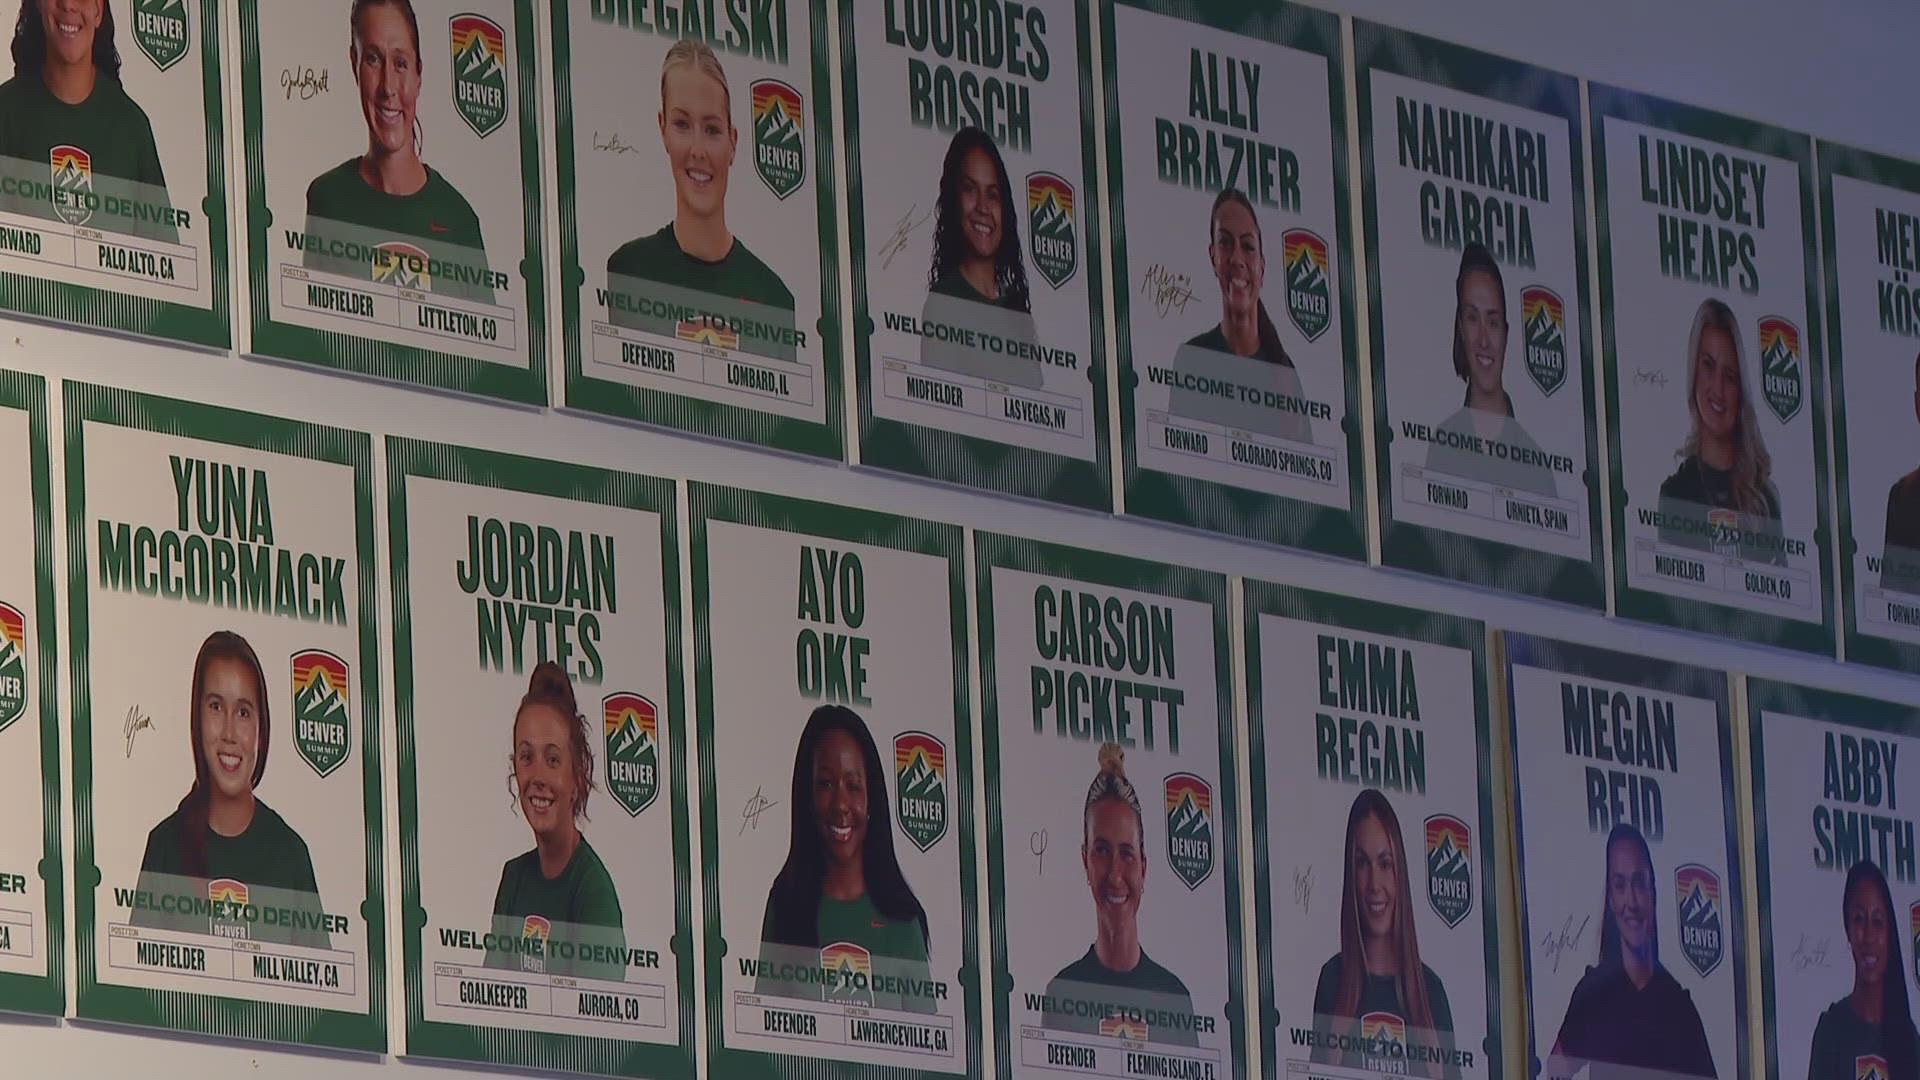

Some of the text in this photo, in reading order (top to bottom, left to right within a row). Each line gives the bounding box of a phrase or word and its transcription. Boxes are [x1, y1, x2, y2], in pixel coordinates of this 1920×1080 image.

[137, 11, 184, 41] DENVER
[884, 0, 1050, 82] LOURDES
[459, 80, 502, 109] DENVER
[908, 57, 1032, 154] BOSCH
[1189, 47, 1260, 133] ALLY
[759, 143, 800, 171] DENVER
[1155, 117, 1301, 213] BRAZIER
[1396, 95, 1549, 203] NAHIKARI
[1639, 135, 1766, 229] LINDSEY
[104, 195, 191, 229] DENVER
[1419, 179, 1536, 271] GARCIA
[98, 245, 175, 280] PALO ALTO, CA
[285, 230, 509, 291] WELCOME TO DENVER
[1034, 233, 1073, 262] DENVER
[1658, 213, 1759, 296] HEAPS
[307, 284, 374, 318] MIDFIELDER
[596, 288, 806, 348] WELCOME TO DENVER
[1290, 288, 1327, 316] DENVER
[418, 305, 497, 341] LITTLETON, CO
[621, 342, 675, 373] DEFENDER
[884, 312, 1077, 370] WELCOME TO DENVER
[1528, 344, 1562, 371] DENVER
[727, 363, 789, 396] LOMBARD, IL
[906, 376, 964, 408] MIDFIELDER
[1147, 365, 1331, 421] WELCOME TO DENVER
[1765, 373, 1799, 398] DENVER
[1004, 397, 1021, 420] LAS
[1054, 408, 1066, 430] NV
[1164, 427, 1208, 455] FORWARD
[1402, 421, 1573, 474] WELCOME TO DENVER
[1231, 441, 1278, 470] COLORADO
[1320, 459, 1332, 481] CO
[169, 454, 274, 546] YUNA
[1427, 482, 1468, 510] FORWARD
[1506, 500, 1568, 532] URNIETA, SPAIN
[97, 518, 347, 627] MCCORMACK
[456, 515, 617, 614] JORDAN
[1655, 555, 1705, 582] MIDFIELDER
[798, 544, 864, 629] AYO
[1745, 572, 1791, 599] GOLDEN, CO
[477, 597, 604, 686] NYTES
[1034, 584, 1176, 679] CARSON
[796, 627, 872, 708] OKE
[1317, 634, 1421, 721] EMMA
[1030, 665, 1185, 756] PICKETT
[1560, 681, 1678, 773] MEGAN
[299, 719, 345, 746] DENVER
[305, 744, 339, 756] SUMMIT
[316, 755, 329, 764] FC
[1315, 713, 1426, 796] REGAN
[610, 760, 654, 786] DENVER
[1824, 731, 1898, 811] ABBY
[617, 784, 649, 795] SUMMIT
[627, 795, 639, 803] FC
[1585, 766, 1664, 842] REID
[901, 797, 942, 821] DENVER
[908, 820, 938, 831] SUMMIT
[1171, 836, 1209, 860] DENVER
[1813, 805, 1916, 884] SMITH
[1431, 876, 1468, 900] DENVER
[114, 887, 349, 935] WELCOME TO DENVER
[439, 928, 659, 969] WELCOME TO DENVER
[1683, 926, 1719, 949] DENVER
[136, 941, 205, 972] MIDFIELDER
[253, 954, 339, 989] MILL VALLEY, CA
[459, 980, 528, 1010] GOALKEEPER
[739, 958, 948, 1000] WELCOME TO DENVER
[578, 992, 639, 1021] AURORA, CO
[764, 1009, 817, 1037] DEFENDER
[1024, 993, 1215, 1034] WELCOME TO DENVER
[850, 1019, 948, 1052] LAWRENCEVILLE, GA
[1047, 1043, 1096, 1069] DEFENDER
[1127, 1053, 1167, 1077] FLEMING
[1205, 1063, 1215, 1080] FL
